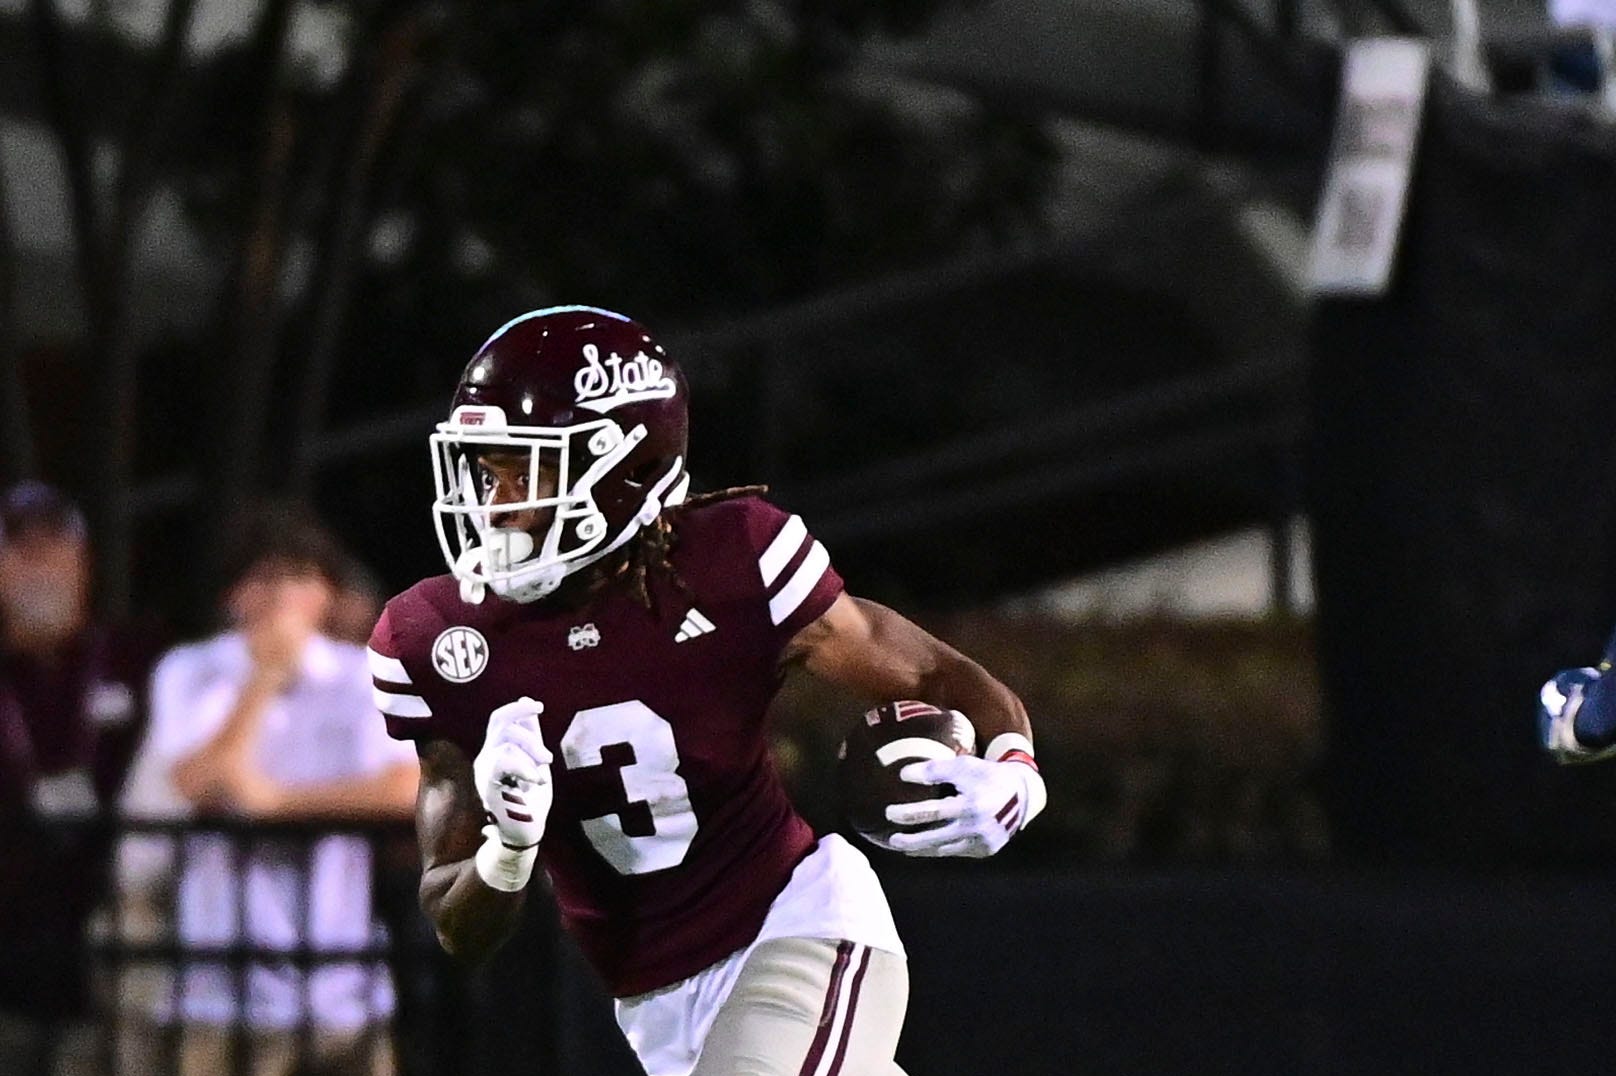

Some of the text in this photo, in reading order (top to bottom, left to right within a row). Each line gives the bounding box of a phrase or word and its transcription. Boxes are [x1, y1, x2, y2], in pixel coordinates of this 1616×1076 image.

[574, 343, 677, 414] State
[434, 628, 487, 681] SEC
[559, 699, 700, 875] 3
